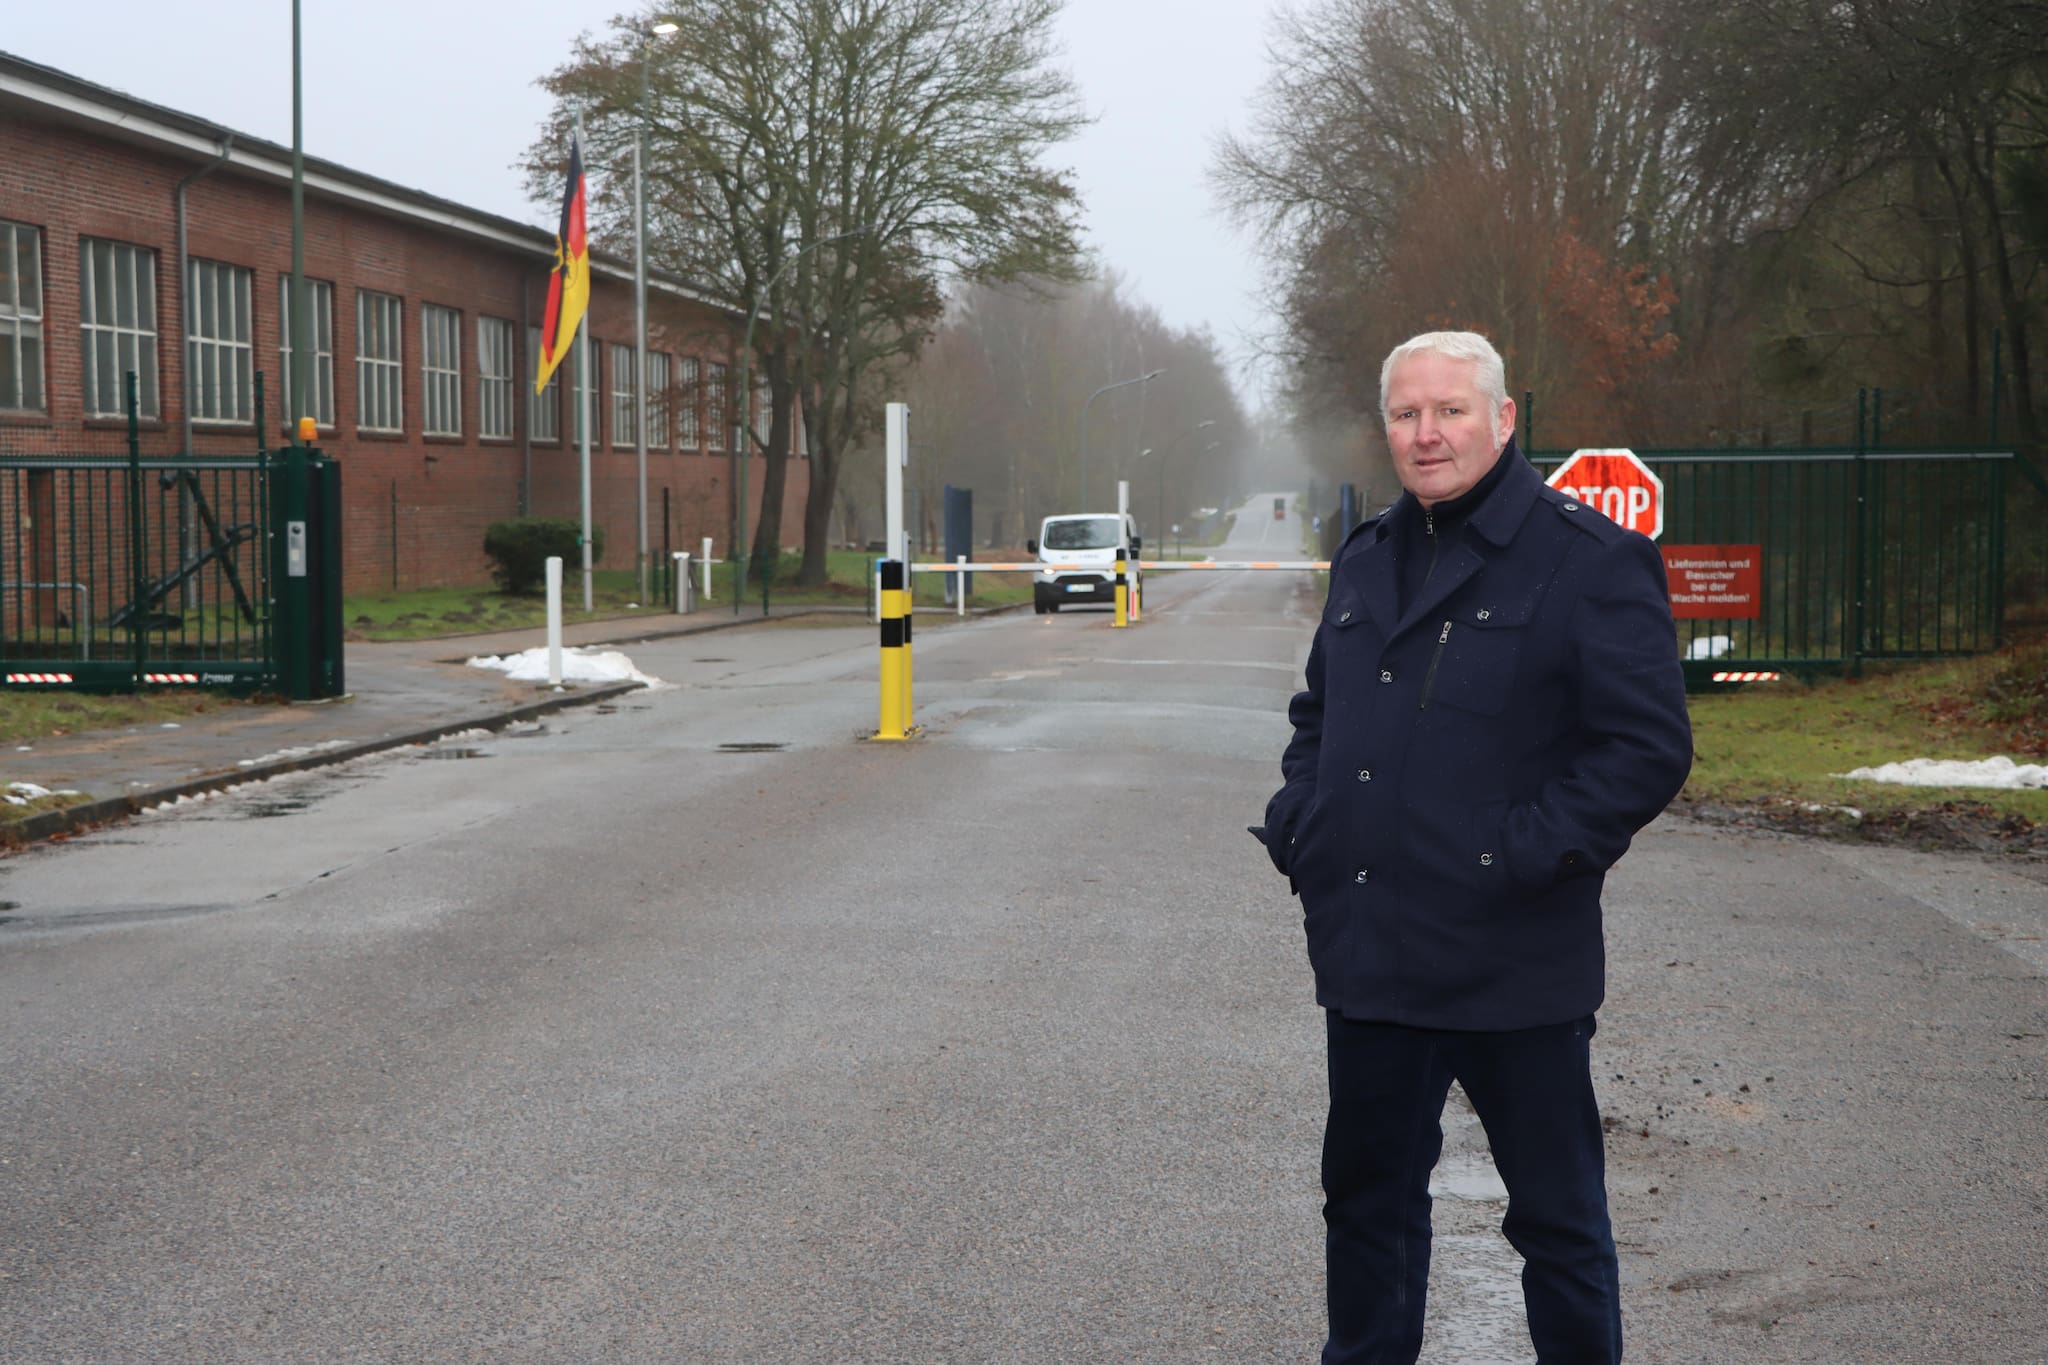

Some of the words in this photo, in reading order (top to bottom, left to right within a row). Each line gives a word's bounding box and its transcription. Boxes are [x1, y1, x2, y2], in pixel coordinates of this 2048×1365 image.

[1560, 486, 1650, 530] TOP
[1668, 559, 1727, 569] Lieferanten
[1728, 559, 1750, 569] und
[1685, 570, 1735, 580] Besucher
[1690, 582, 1707, 592] bei
[1708, 582, 1727, 592] der
[1671, 593, 1706, 603] Wache
